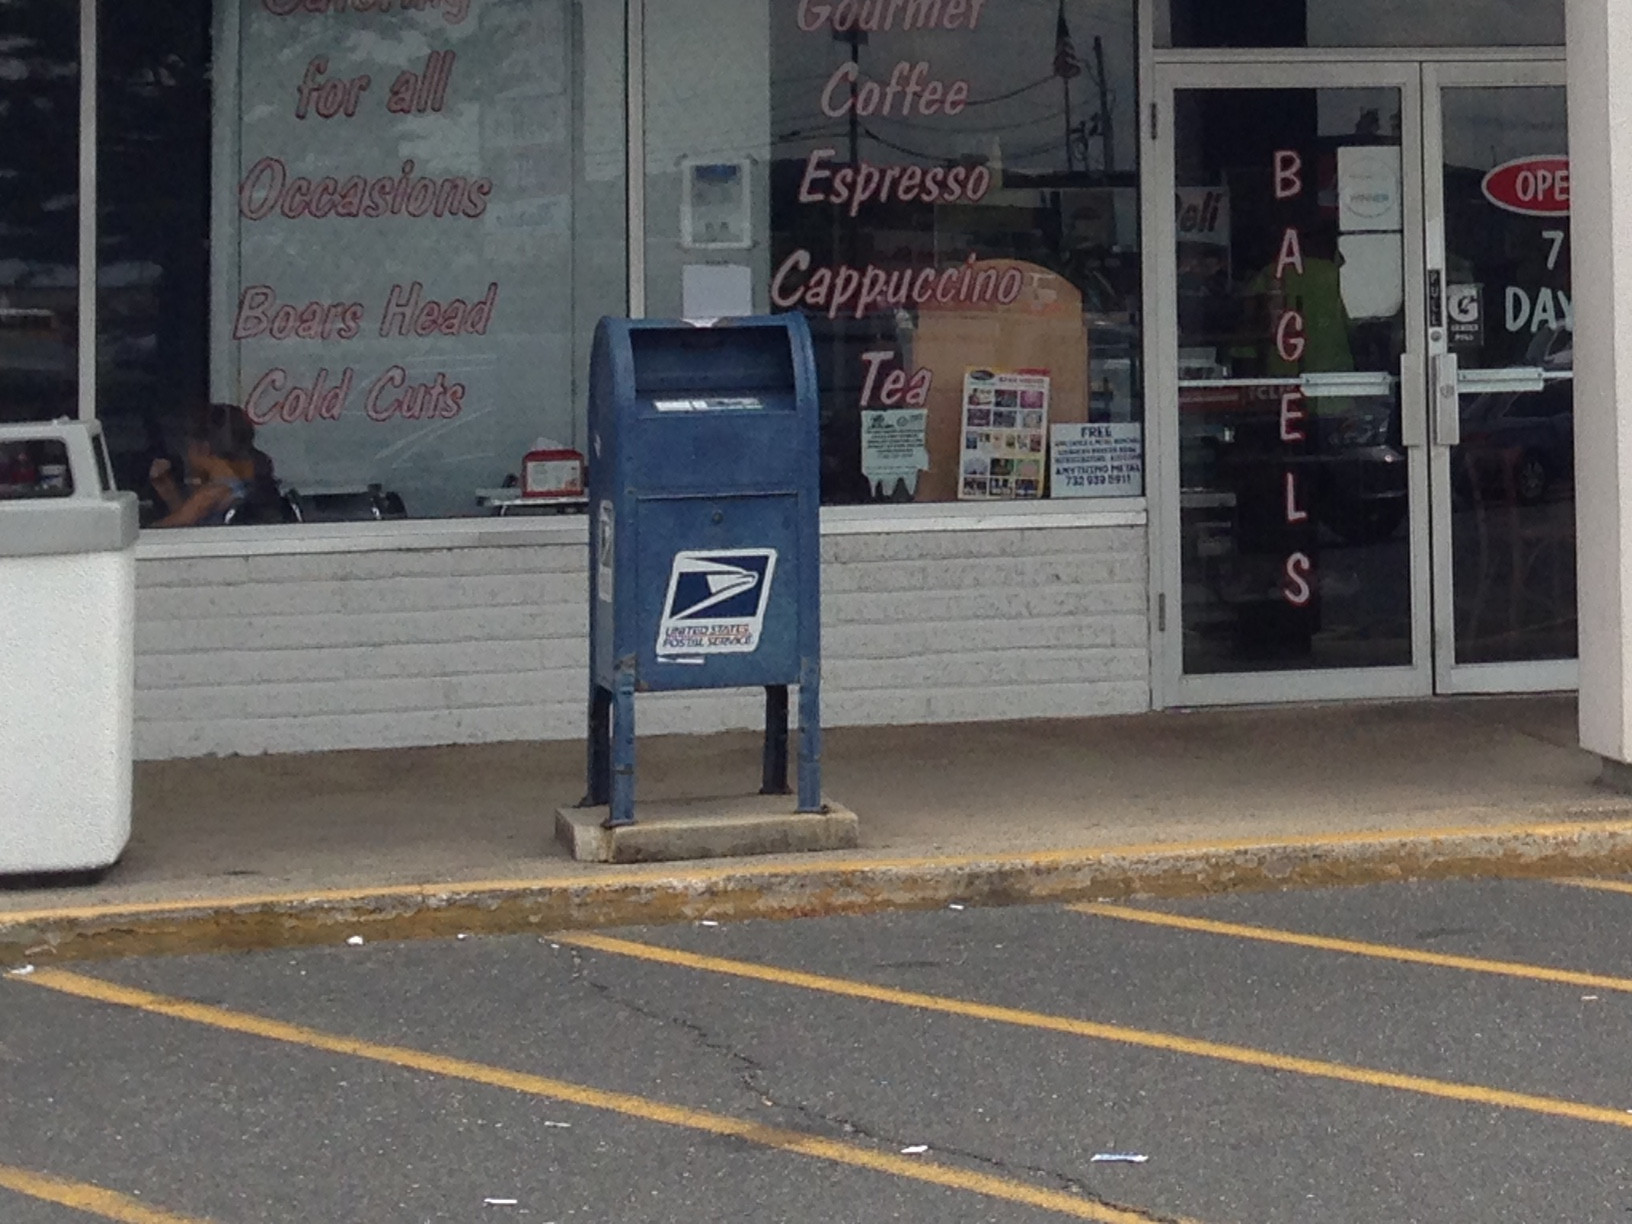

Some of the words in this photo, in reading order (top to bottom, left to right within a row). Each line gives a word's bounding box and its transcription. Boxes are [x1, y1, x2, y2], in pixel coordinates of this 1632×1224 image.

[295, 55, 370, 120] for
[386, 49, 455, 114] all
[820, 61, 968, 118] Coffee
[239, 156, 491, 221] Occasions
[800, 148, 991, 217] Espresso
[1515, 170, 1570, 203] OPE
[1541, 229, 1565, 271] 7
[233, 284, 363, 341] Boars
[380, 282, 498, 337] Head
[770, 249, 1021, 319] Cappuccino
[1505, 286, 1573, 333] DAY
[243, 366, 352, 426] Cold
[365, 365, 466, 422] Cuts
[858, 351, 932, 408] Tea
[1271, 148, 1314, 606] BAGELS
[665, 625, 709, 637] UNITED
[709, 624, 750, 636] STATES
